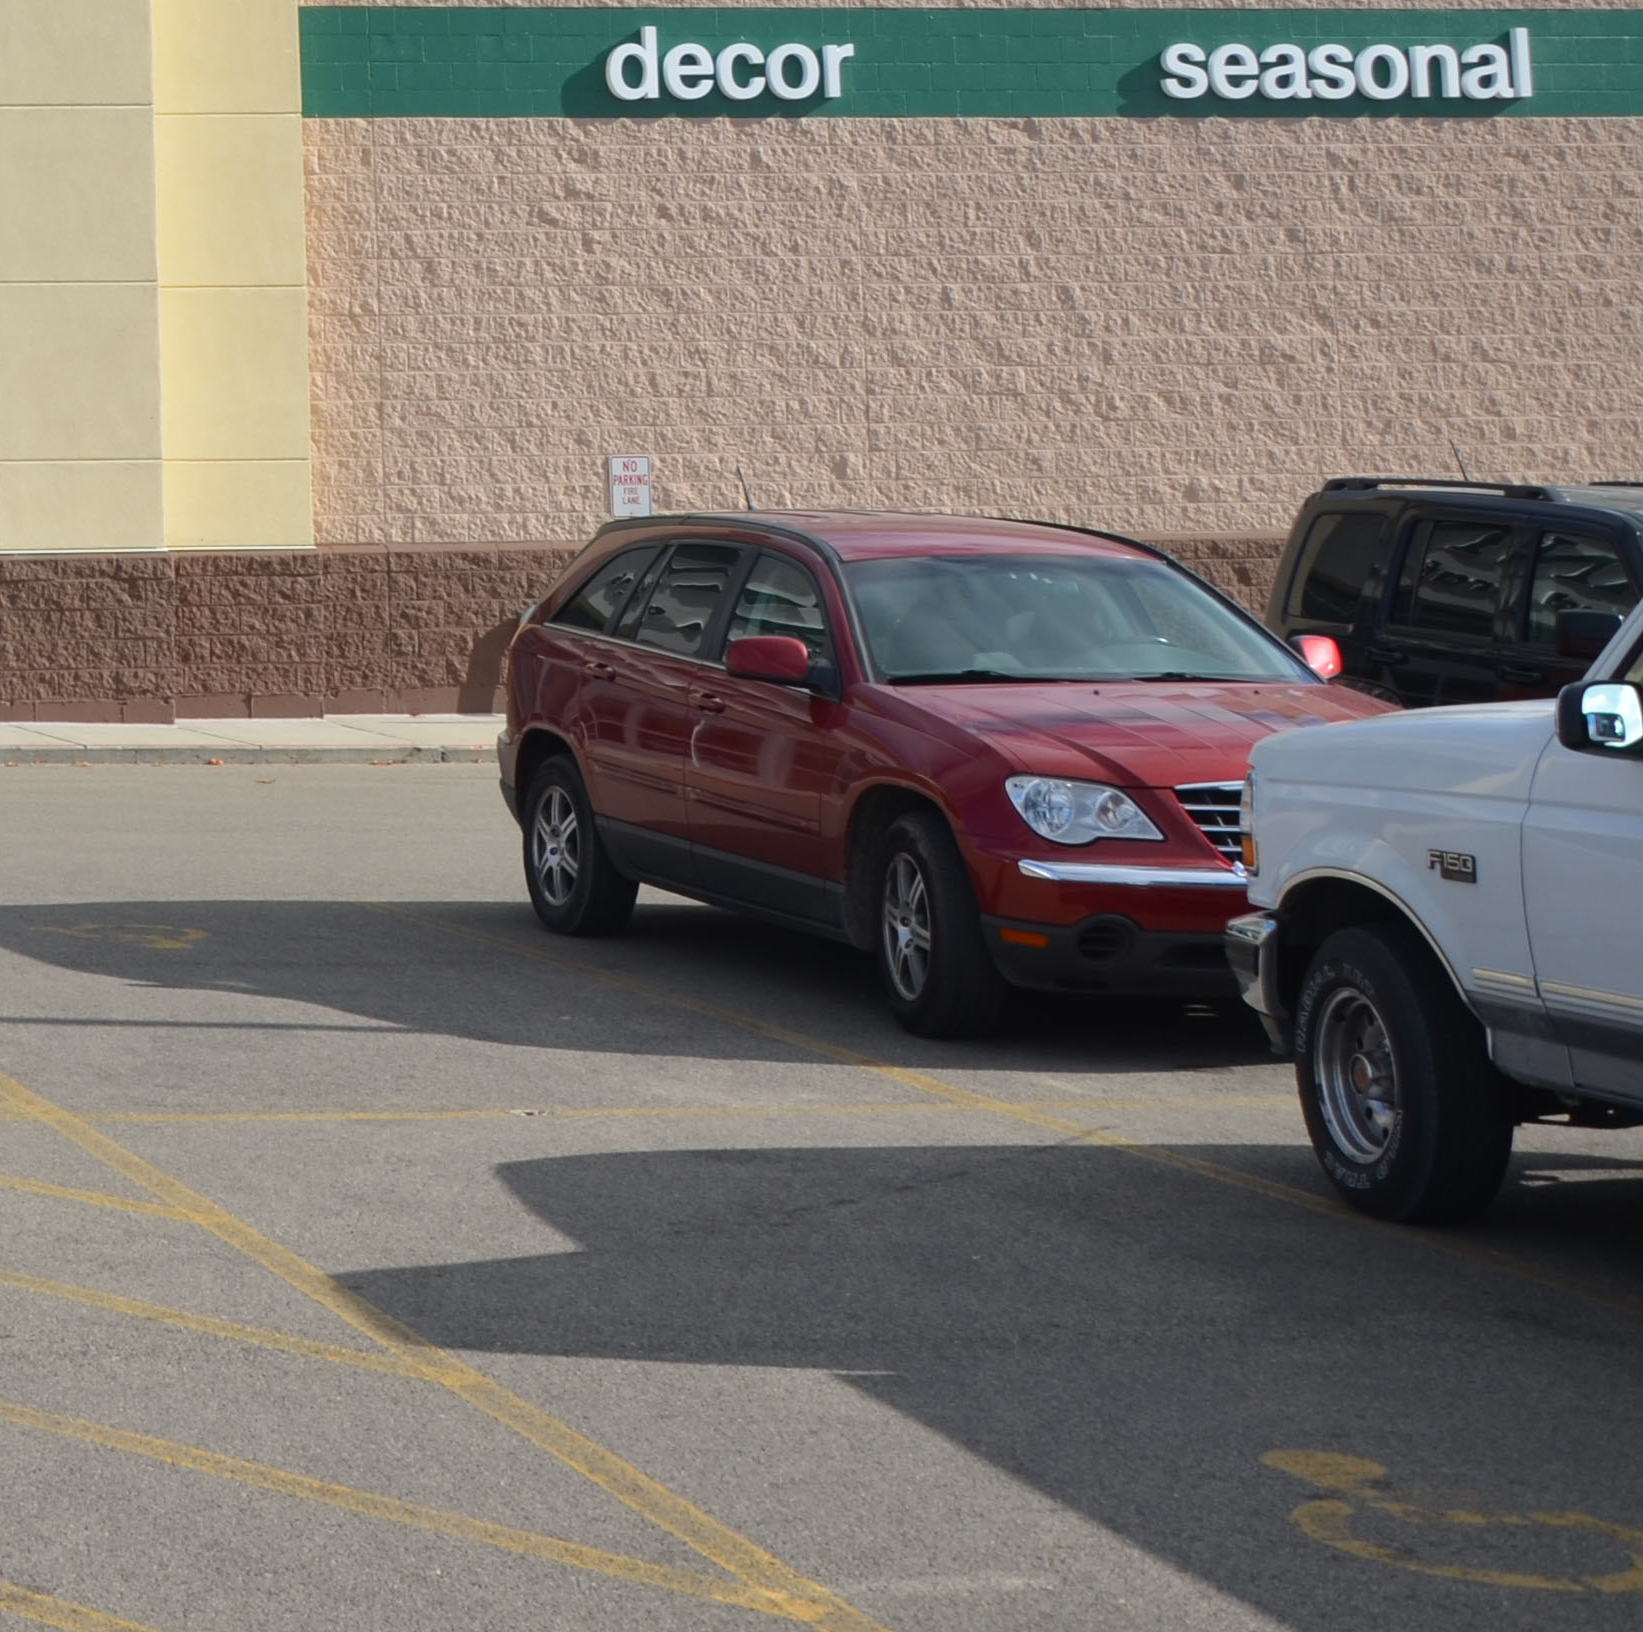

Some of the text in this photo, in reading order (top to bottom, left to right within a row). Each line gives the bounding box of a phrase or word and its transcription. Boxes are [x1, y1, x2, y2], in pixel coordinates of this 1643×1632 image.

[605, 25, 854, 100] decor
[1159, 27, 1533, 99] seasonal
[623, 461, 638, 472] NO
[614, 474, 648, 486] PARKING
[622, 496, 640, 504] LANE
